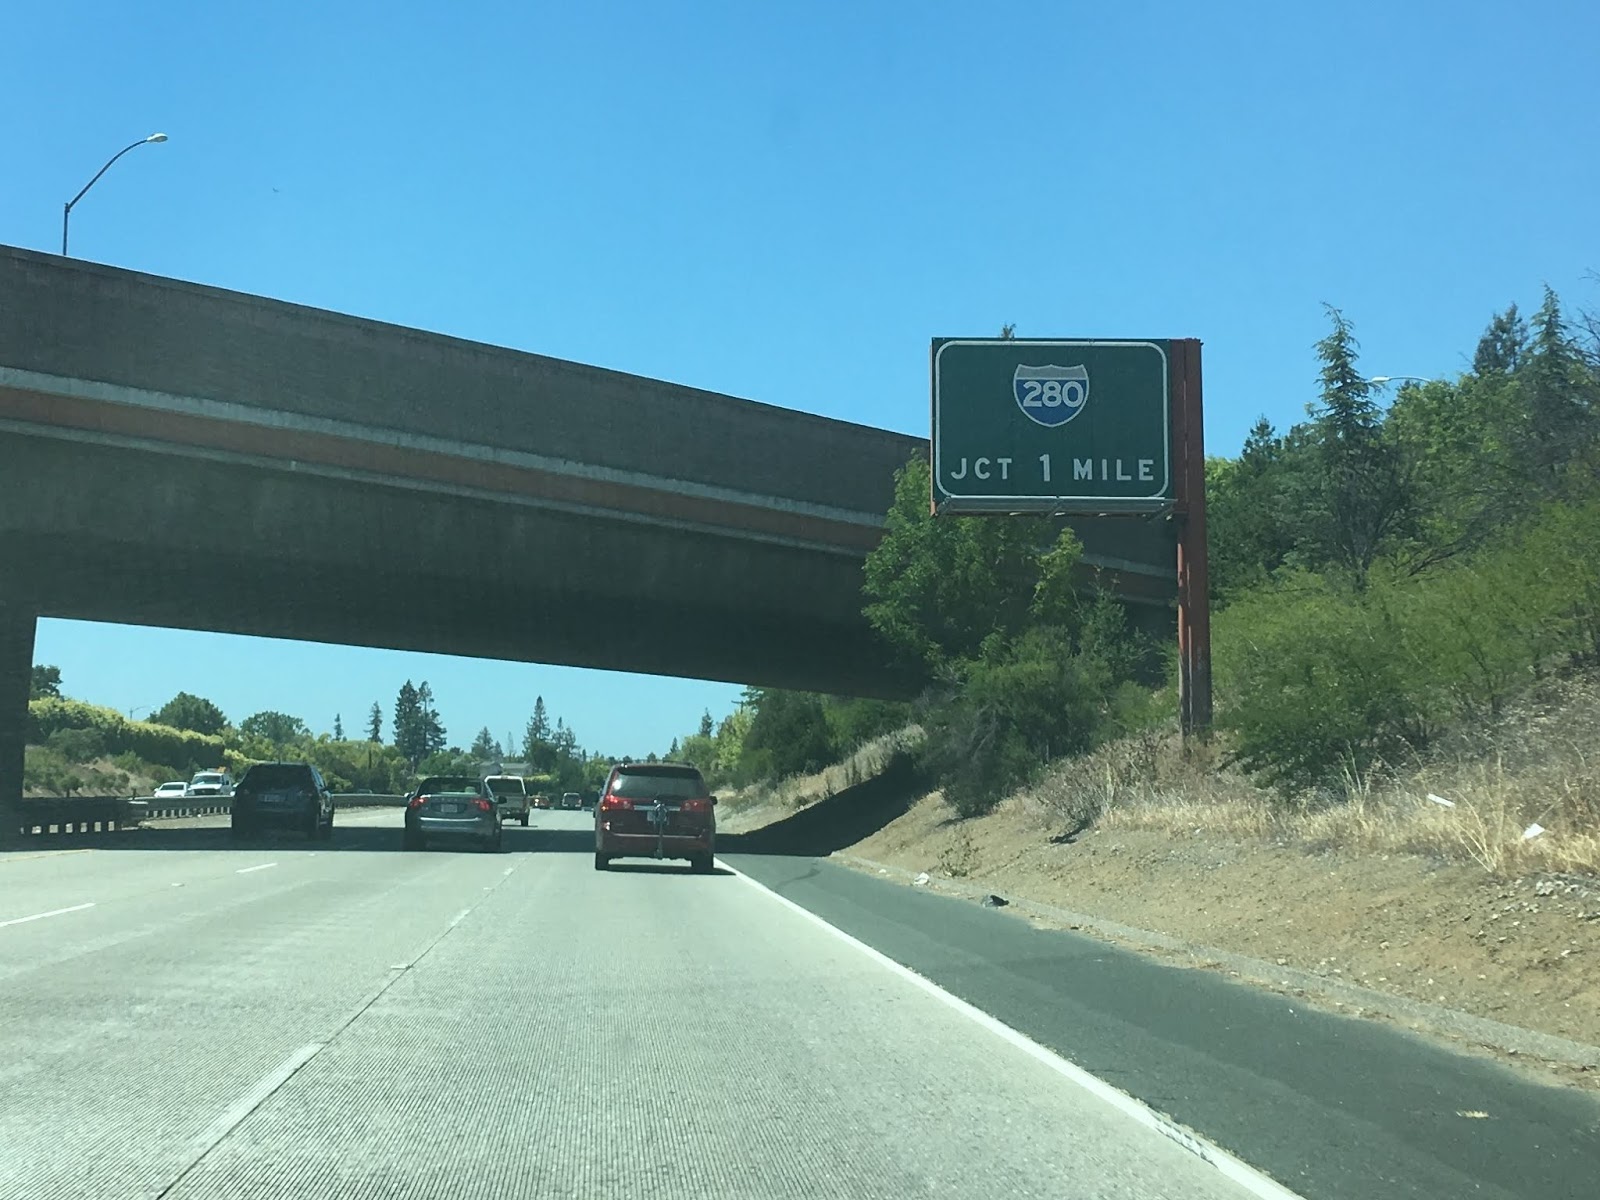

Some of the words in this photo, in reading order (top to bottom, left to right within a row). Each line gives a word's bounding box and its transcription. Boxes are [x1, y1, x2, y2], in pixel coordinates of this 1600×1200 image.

[1023, 381, 1084, 407] 280
[951, 457, 1012, 480] JCT
[1039, 453, 1050, 482] 1
[1073, 458, 1154, 481] MILE
